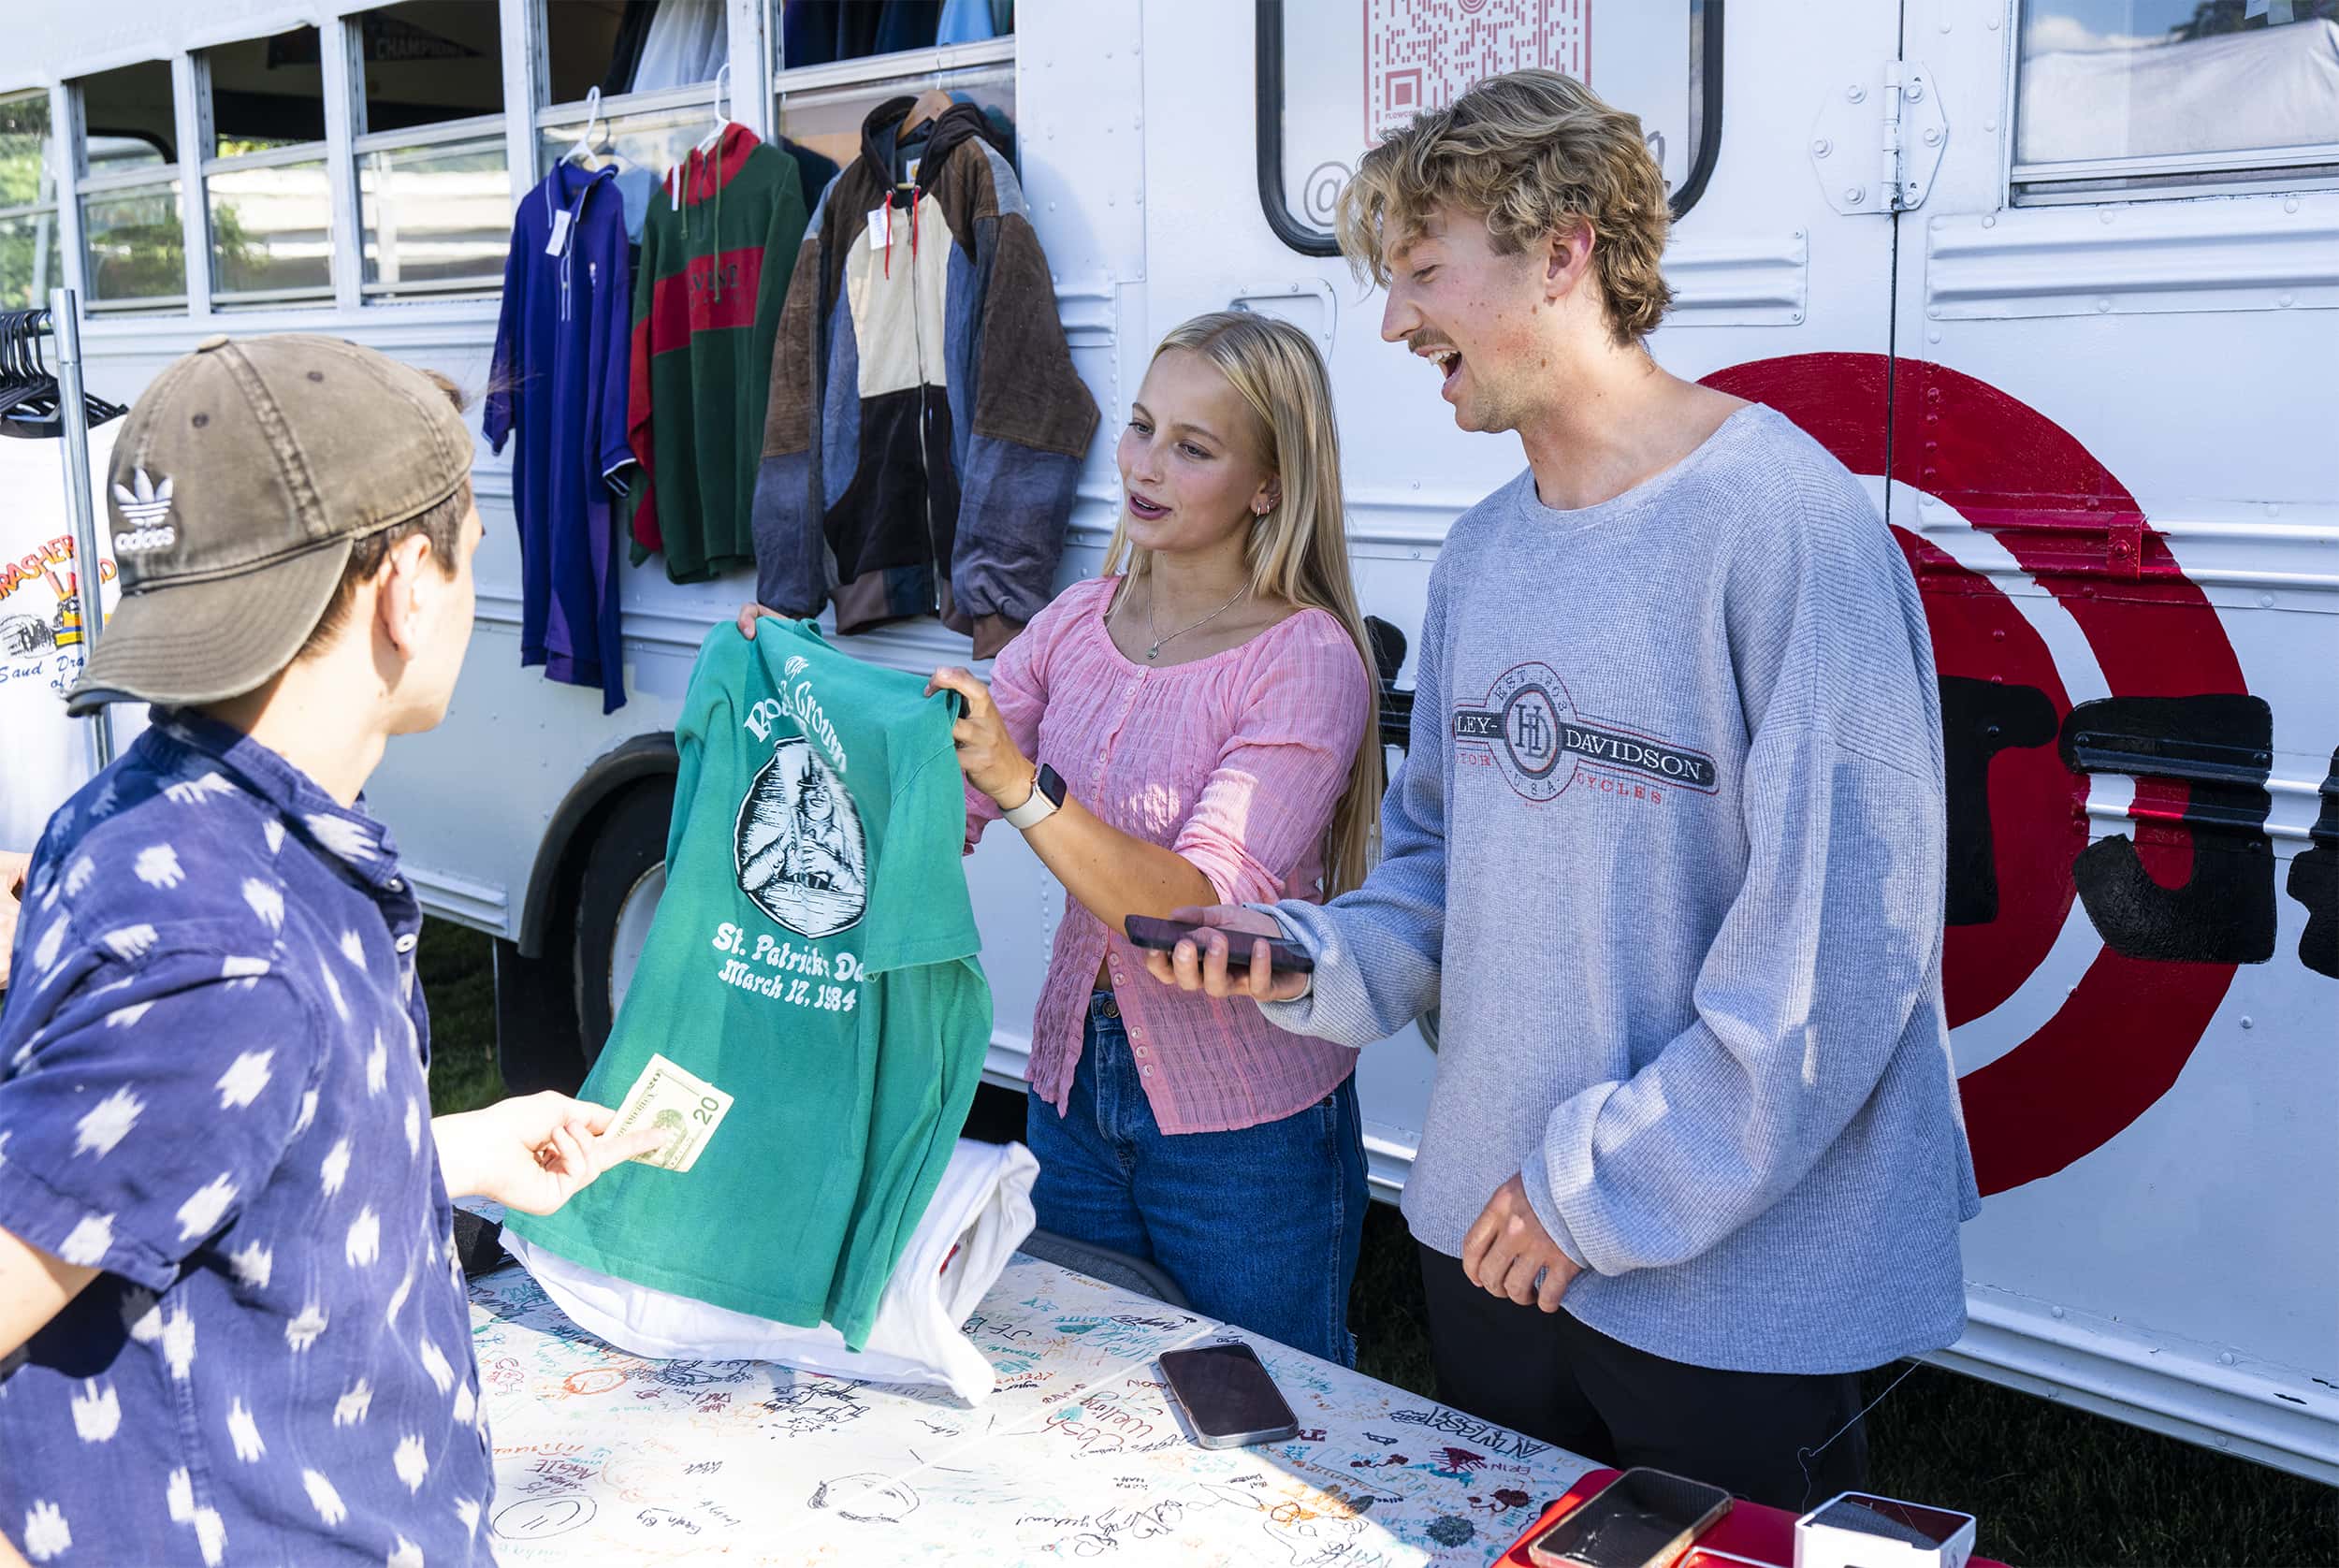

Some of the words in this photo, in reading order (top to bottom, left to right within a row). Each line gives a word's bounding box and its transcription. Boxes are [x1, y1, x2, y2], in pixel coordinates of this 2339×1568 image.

[114, 526, 175, 551] adidas
[1565, 728, 1702, 781] DAVIDSON
[1576, 772, 1662, 805] CYCLES
[712, 922, 747, 956] St.
[719, 958, 784, 999] March
[692, 1096, 719, 1125] 20
[1490, 1462, 1532, 1475] ERIN
